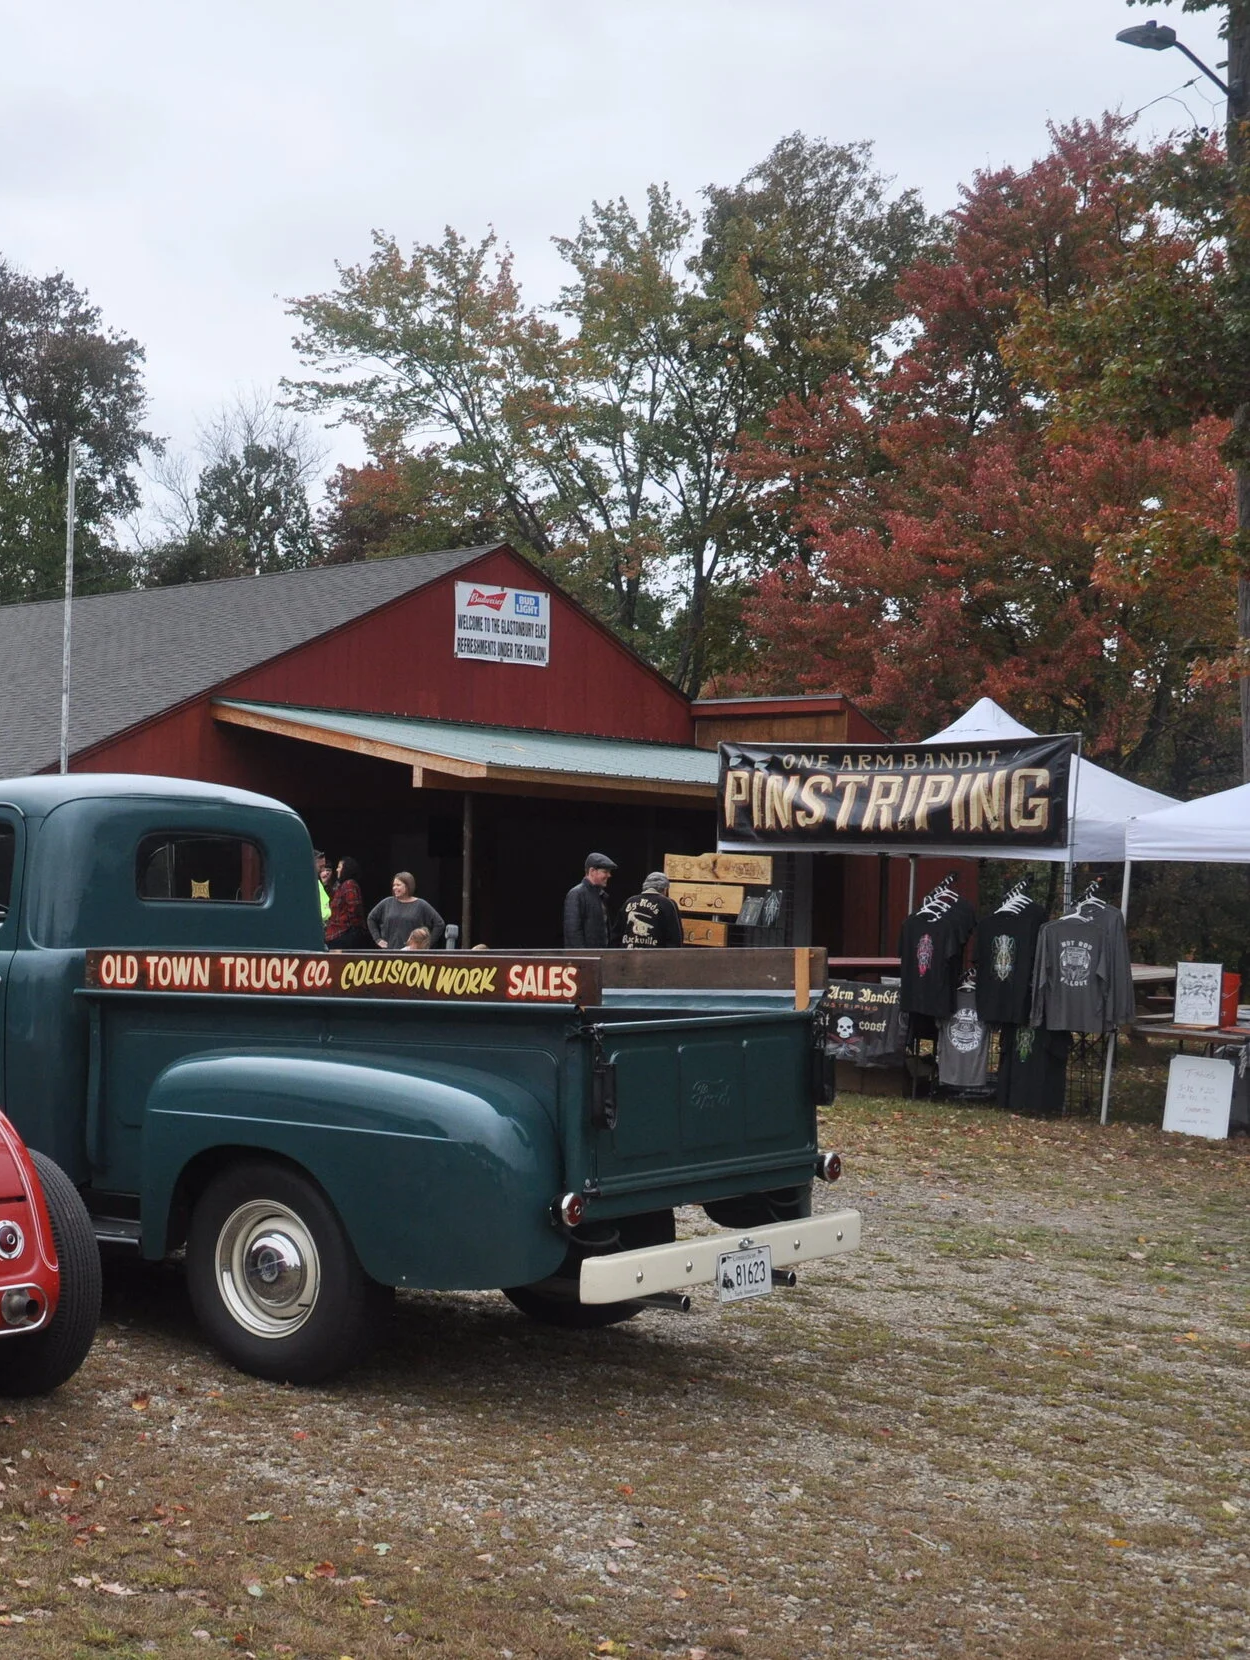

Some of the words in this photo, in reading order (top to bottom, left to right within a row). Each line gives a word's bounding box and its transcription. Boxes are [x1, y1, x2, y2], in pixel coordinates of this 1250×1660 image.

[470, 592, 504, 605] Budweiser
[518, 595, 535, 606] BUD
[516, 604, 538, 615] LIGHT
[458, 614, 483, 632] WELCOME
[484, 616, 490, 632] TO
[491, 617, 500, 634] THE
[501, 619, 534, 638] GLASTONBURY
[535, 623, 546, 639] ELKS
[457, 637, 497, 656] REFRESHMENTS
[498, 641, 513, 658] UNDER
[514, 643, 523, 659] THE
[782, 753, 830, 770] ONE
[839, 753, 894, 771] ARM
[903, 750, 1000, 770] BANDIT
[724, 768, 1051, 833] PINSTRIPING
[1061, 940, 1075, 948] HOT
[1078, 940, 1093, 951] ROD
[101, 954, 139, 985] OLD
[146, 956, 210, 987] TOWN
[220, 956, 300, 990] TRUCK
[303, 960, 333, 987] CO.
[340, 959, 436, 990] COLLISION
[435, 965, 498, 995] WORK
[508, 964, 578, 998] SALES
[827, 984, 854, 1000] Arm
[822, 1001, 879, 1012] NSTRIPING
[735, 1260, 766, 1287] 81623
